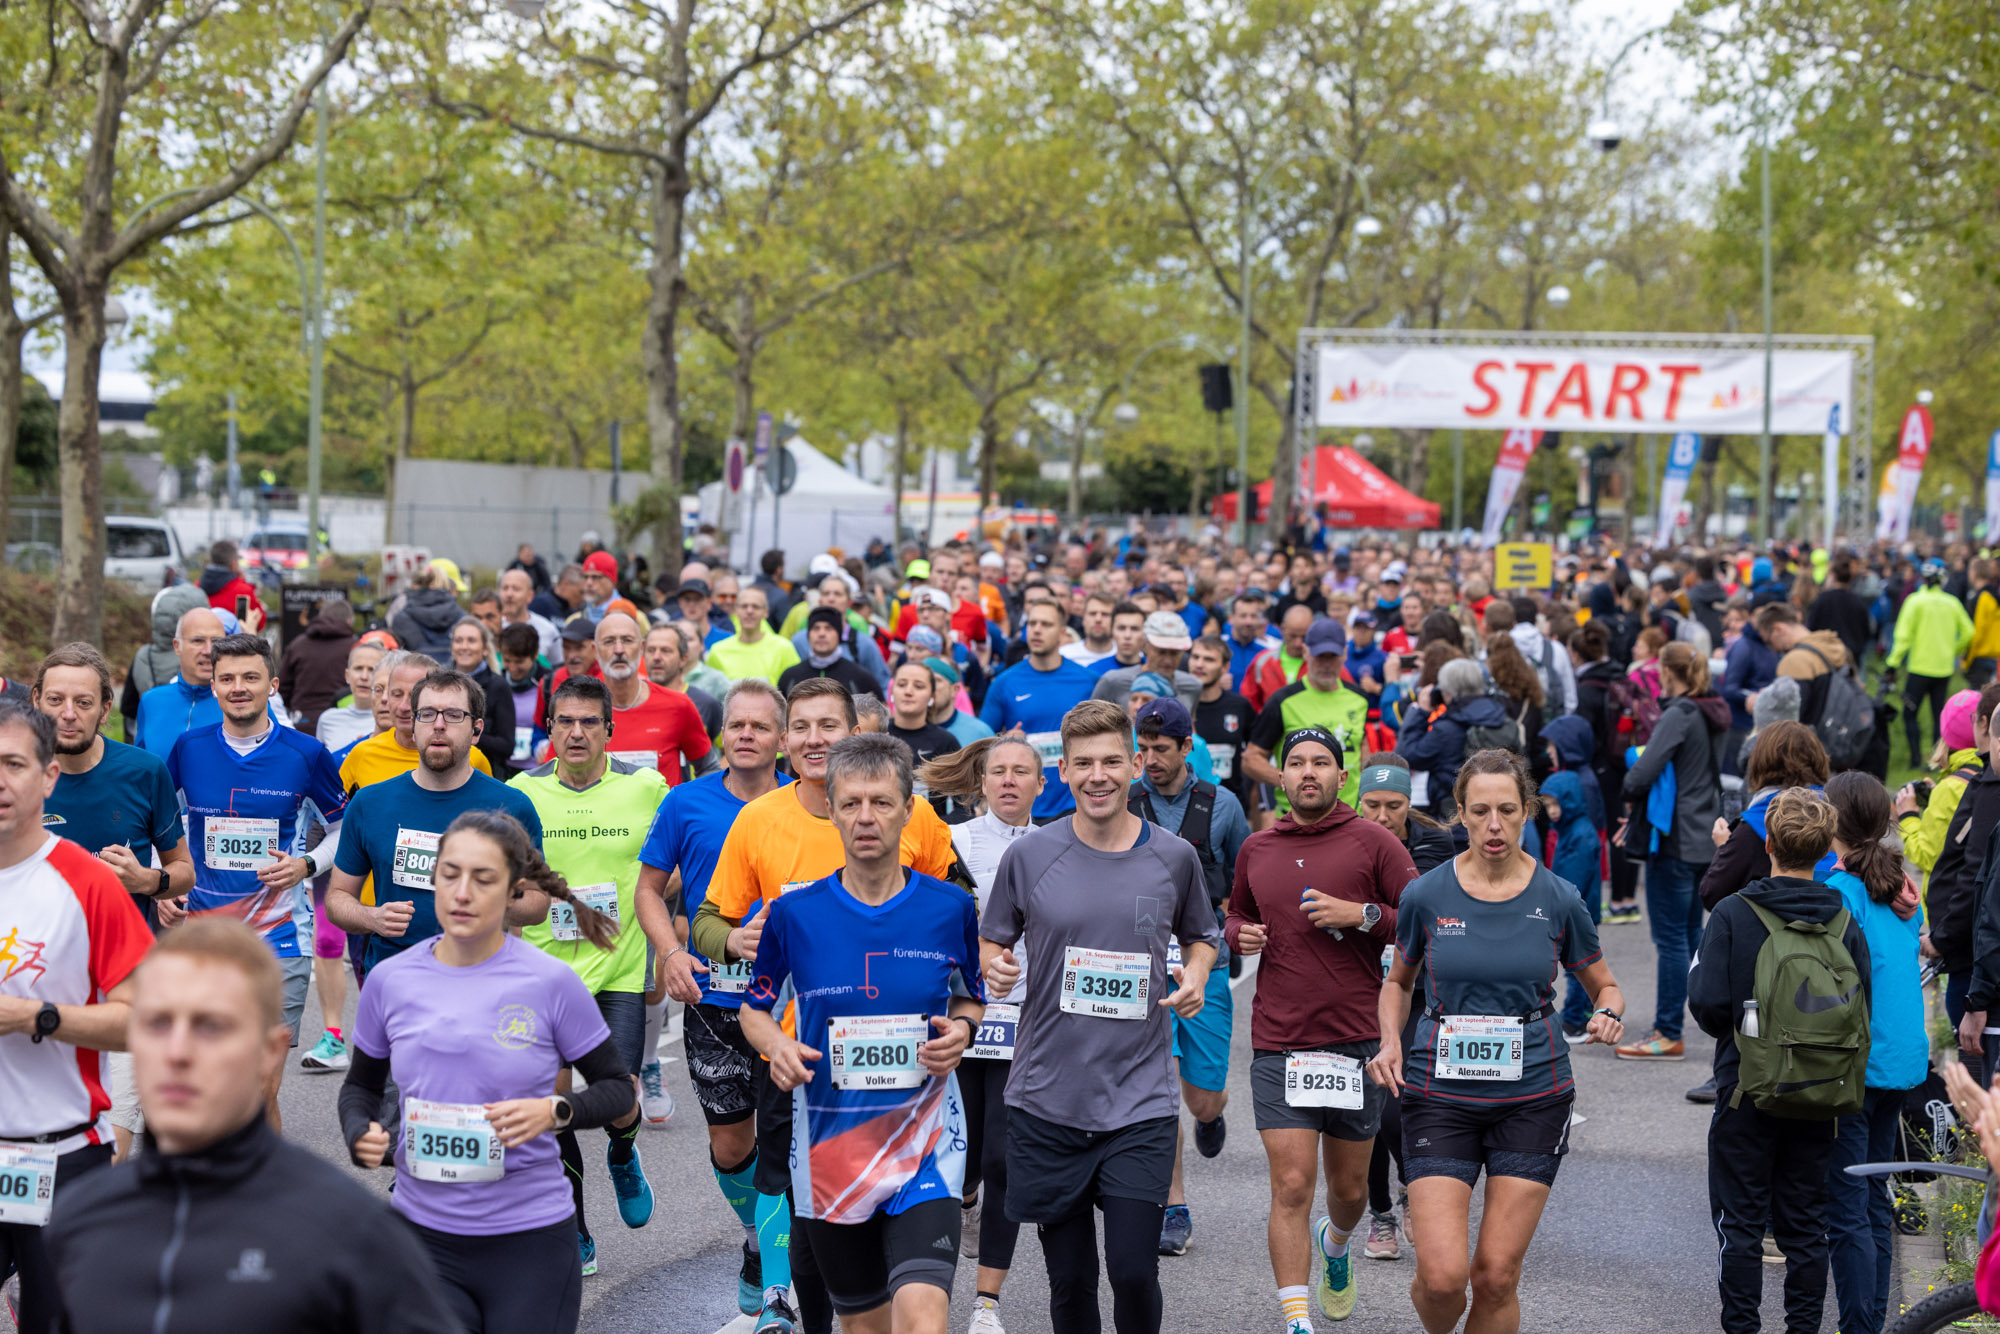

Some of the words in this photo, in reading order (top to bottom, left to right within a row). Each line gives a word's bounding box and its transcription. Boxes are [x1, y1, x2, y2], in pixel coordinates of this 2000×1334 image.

[1463, 359, 1702, 423] START
[1899, 409, 1927, 453] A
[1672, 432, 1696, 466] B
[250, 787, 293, 797] füreinander
[541, 826, 587, 840] unning
[591, 826, 630, 837] Deers
[220, 838, 262, 855] 3032
[229, 860, 253, 869] Holger
[407, 853, 437, 872] 806
[893, 947, 946, 962] füreinander
[1094, 952, 1123, 961] September
[726, 960, 754, 976] 178
[803, 984, 853, 1002] gemeinsam
[1081, 975, 1133, 998] 3392
[1091, 1003, 1119, 1015] Lukas
[851, 1044, 909, 1067] 2680
[974, 1047, 1001, 1057] Valerie
[1455, 1041, 1505, 1061] 1057
[865, 1075, 897, 1085] Volker
[1457, 1068, 1501, 1077] Alexandra
[1302, 1073, 1347, 1091] 9235
[421, 1133, 480, 1160] 3569
[440, 1167, 457, 1179] Ina
